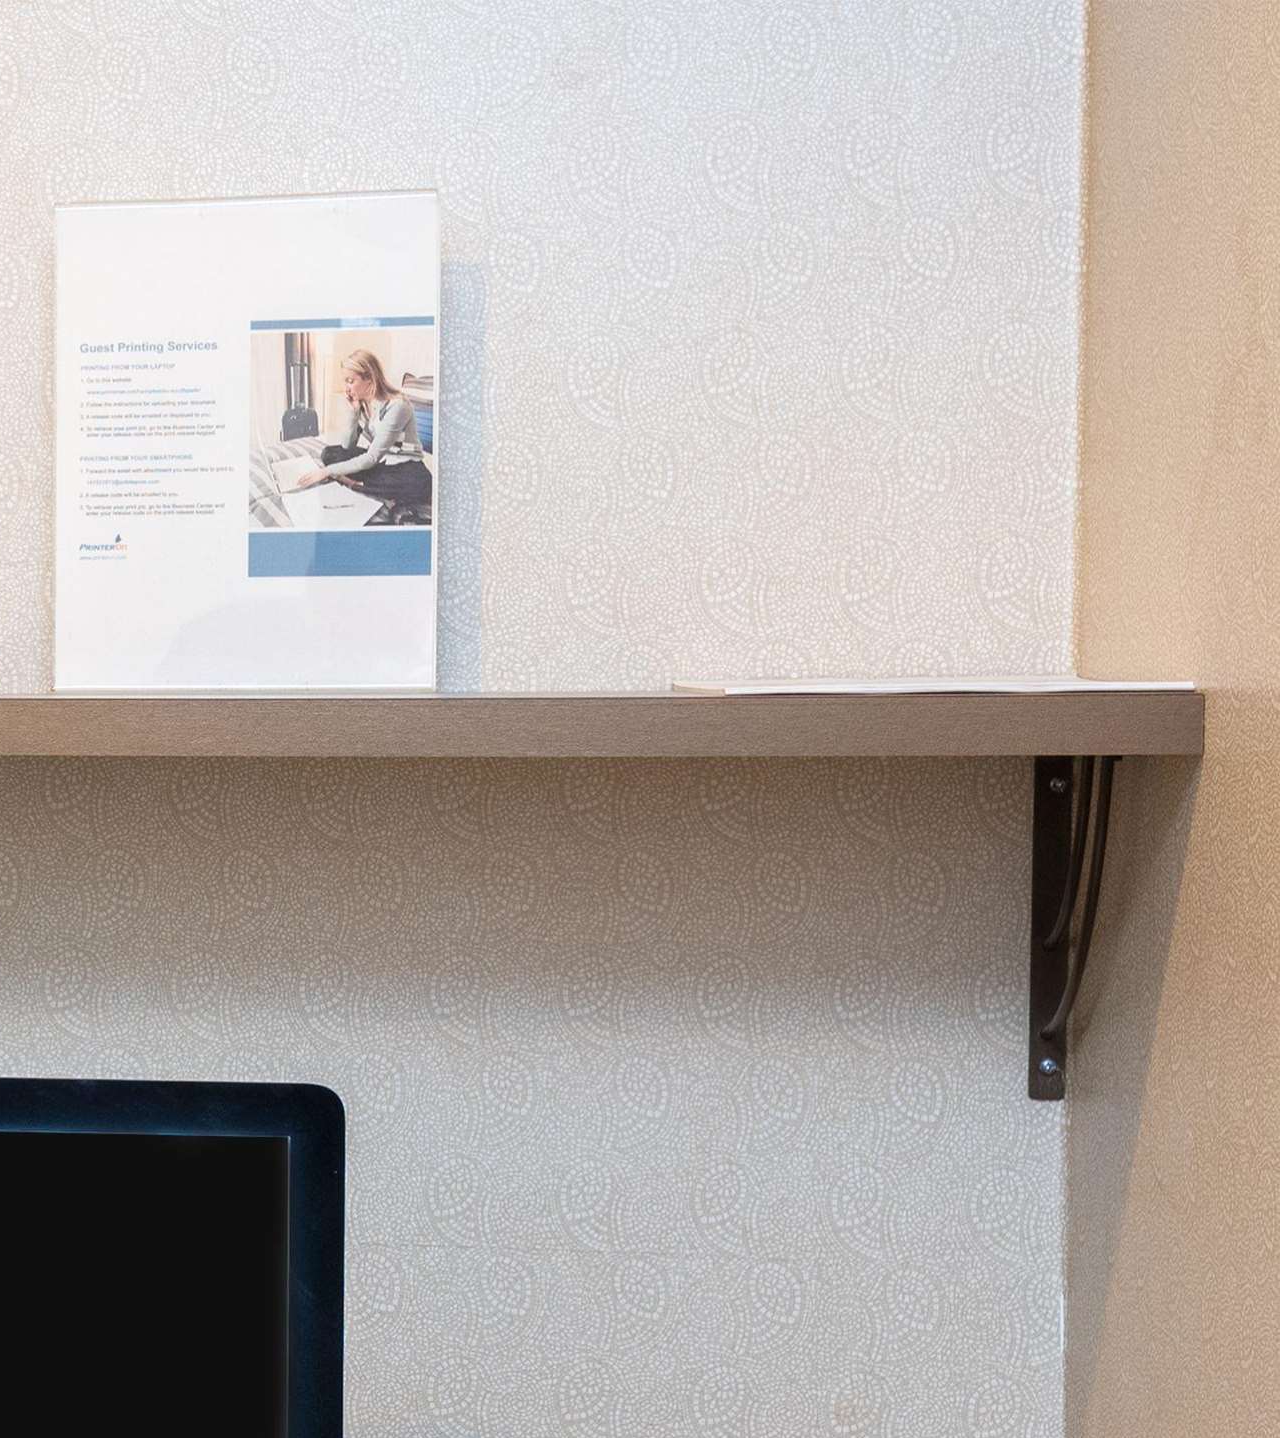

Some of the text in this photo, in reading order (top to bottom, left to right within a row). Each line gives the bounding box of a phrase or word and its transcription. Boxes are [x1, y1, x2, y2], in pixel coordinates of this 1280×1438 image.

[80, 341, 218, 354] Guest Printing Services
